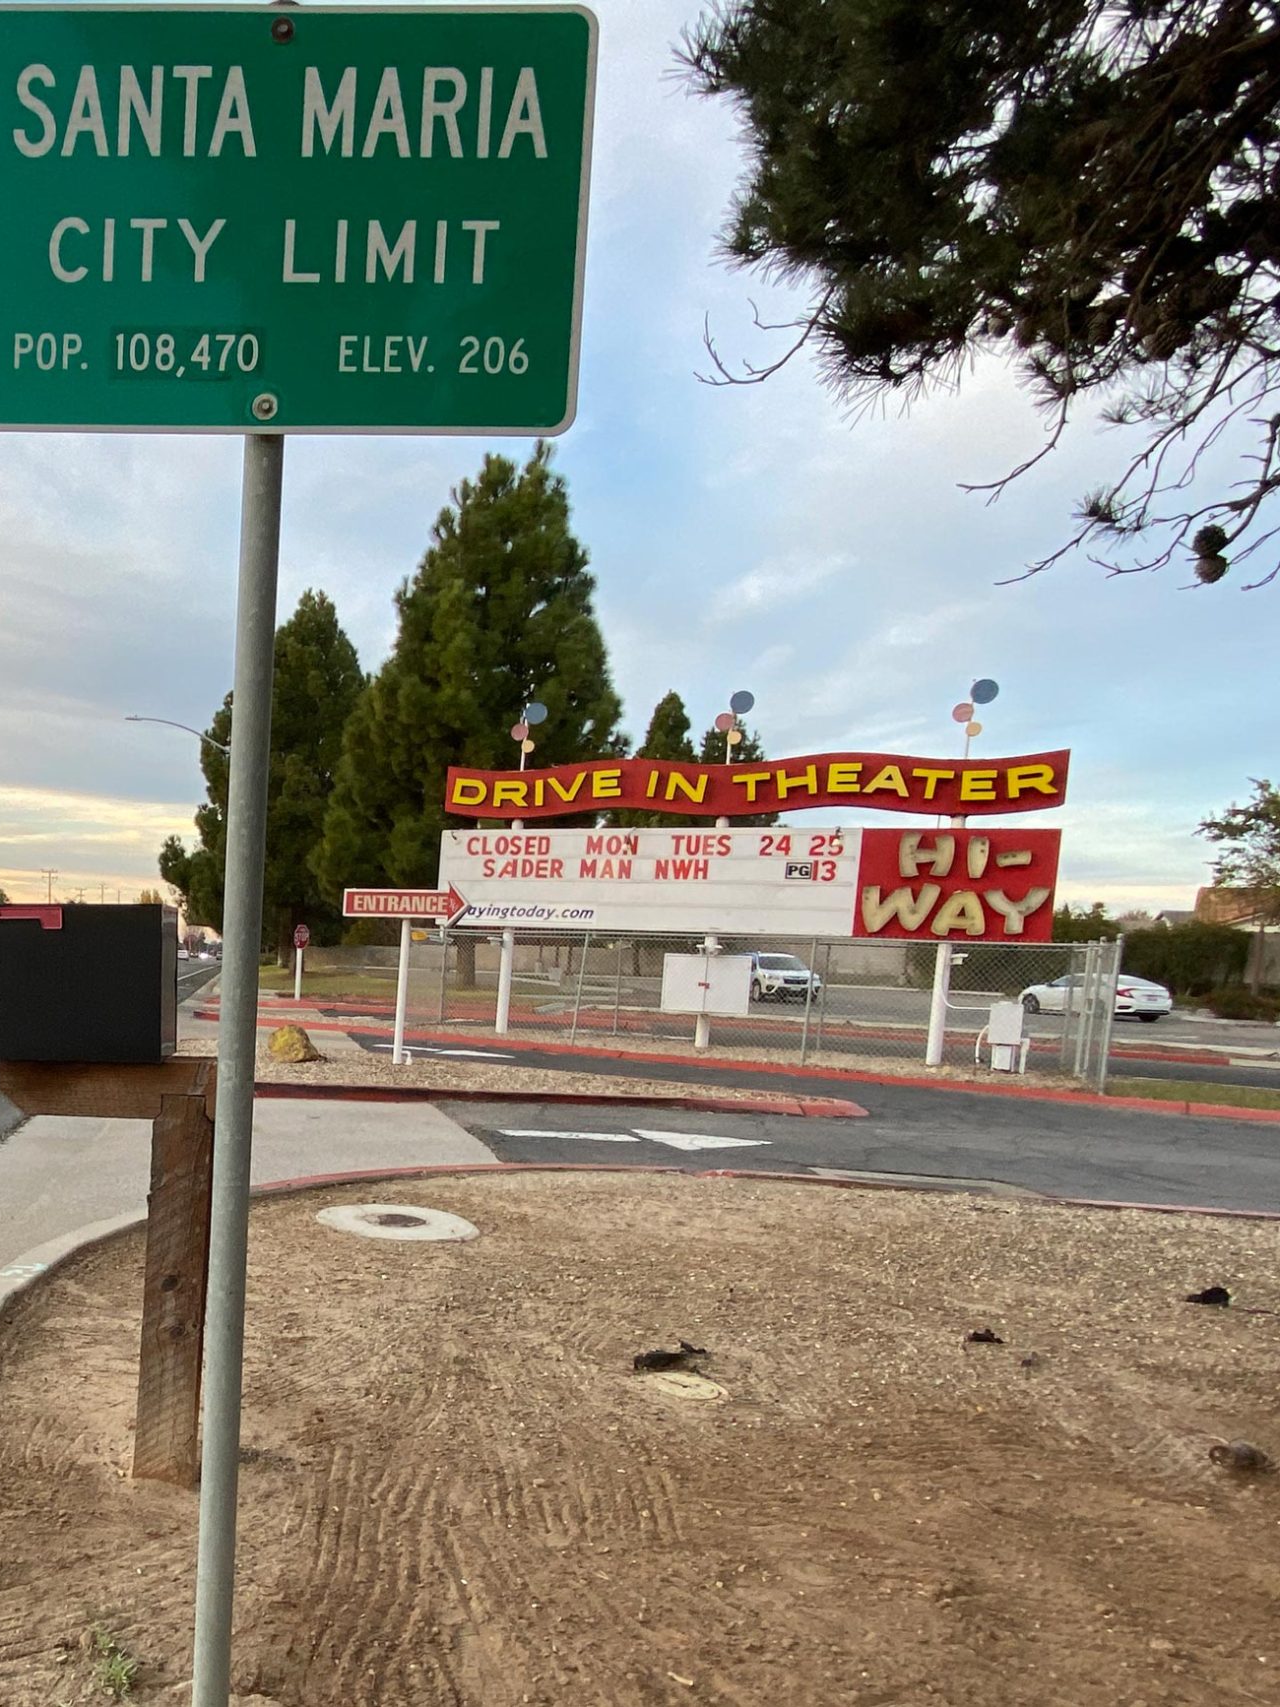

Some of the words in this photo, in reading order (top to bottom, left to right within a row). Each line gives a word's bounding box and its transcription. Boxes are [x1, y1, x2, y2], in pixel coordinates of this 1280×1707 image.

[13, 64, 256, 157] SANTA
[302, 66, 548, 159] MARIA
[49, 217, 226, 283] CITY
[283, 219, 500, 284] LIMIT
[13, 332, 88, 371] POP.
[116, 333, 259, 378] 108,470
[339, 335, 435, 373] ELEV.
[459, 336, 529, 374] 206
[452, 769, 621, 807] DRIVE
[646, 770, 708, 803] IN
[733, 763, 1058, 801] THEATER
[467, 836, 550, 855] CLOSED
[586, 835, 639, 856] MON
[671, 835, 731, 856] TUES
[759, 835, 791, 856] 24
[809, 835, 844, 856] 25
[899, 831, 1032, 878] HI-
[579, 859, 632, 879] MAN
[654, 859, 709, 879] NWH
[353, 894, 448, 913] ENTRANCE
[861, 883, 1051, 936] WAY
